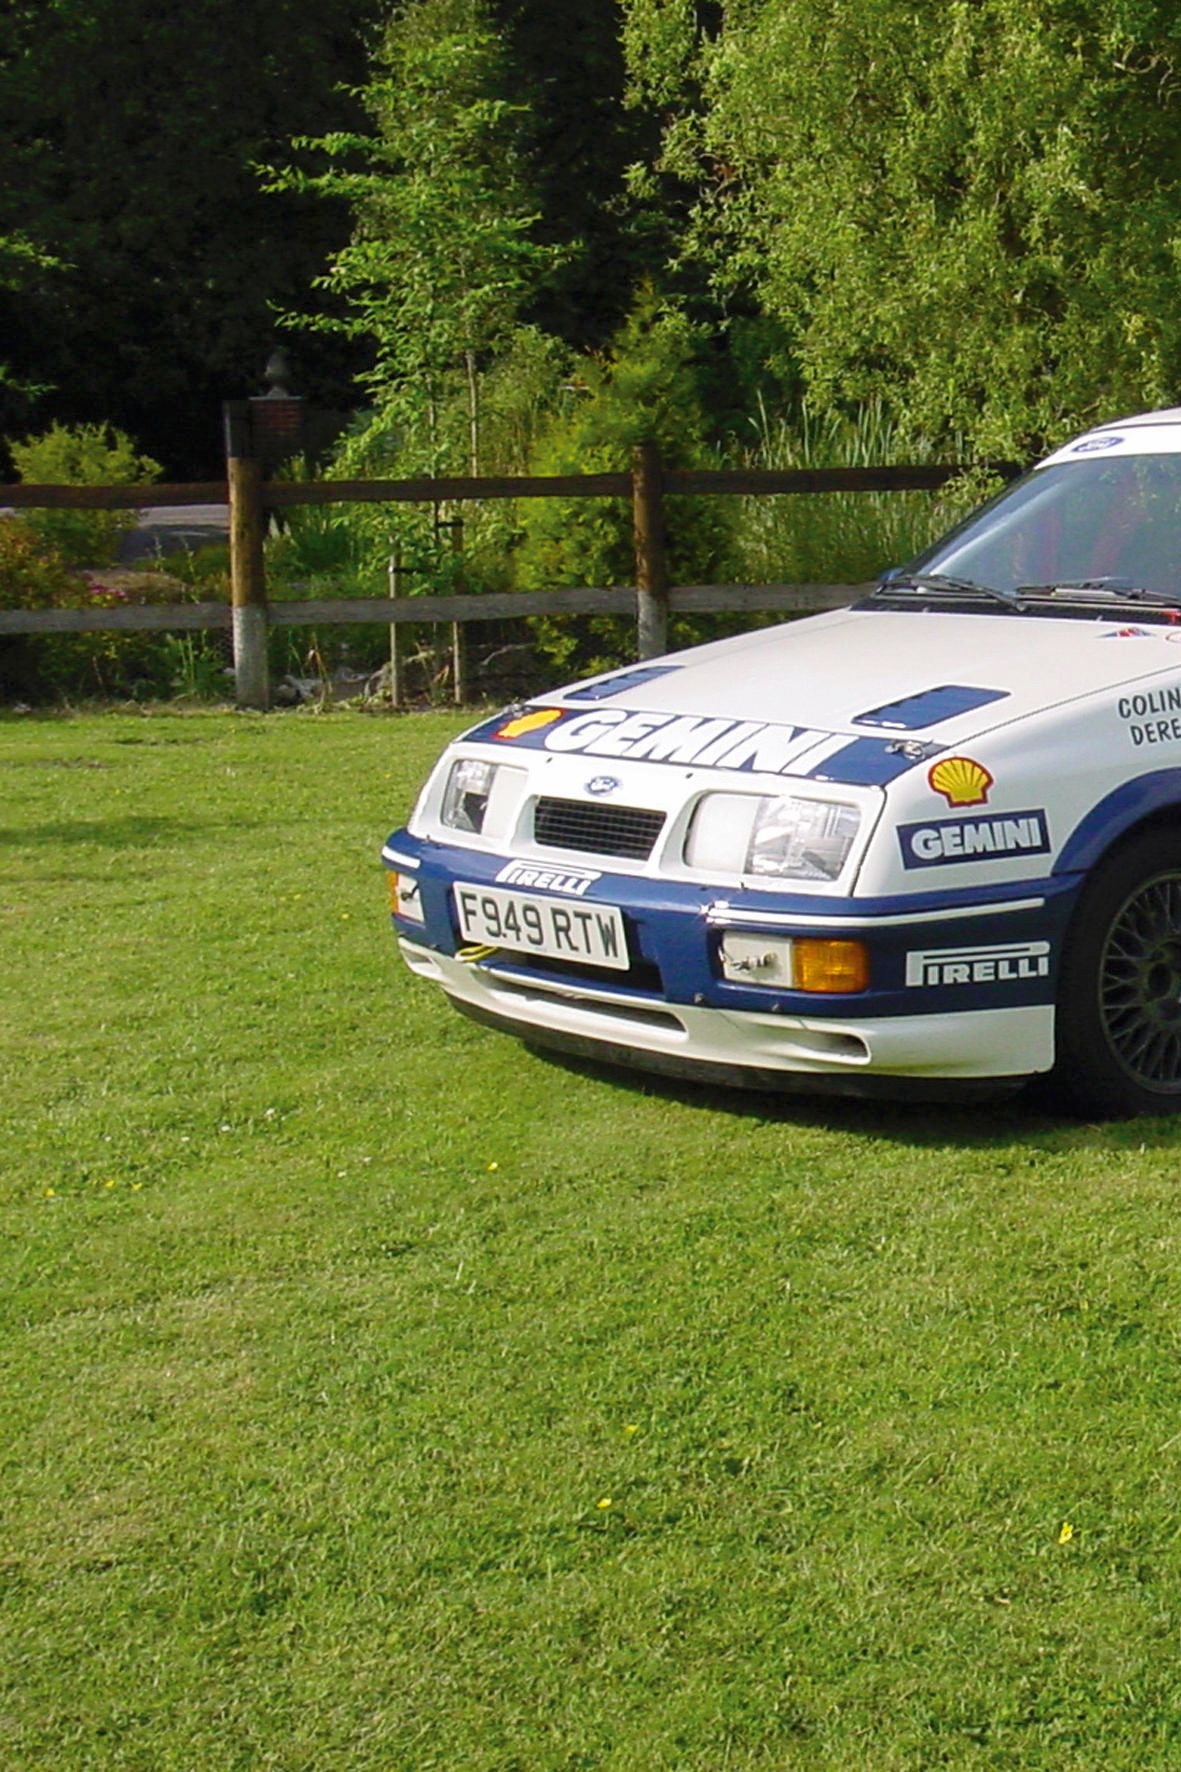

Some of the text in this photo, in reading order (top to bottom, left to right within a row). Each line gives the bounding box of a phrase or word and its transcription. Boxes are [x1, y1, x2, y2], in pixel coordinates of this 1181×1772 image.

[1118, 688, 1181, 718] COLIN
[544, 708, 862, 777] GEMINI
[911, 817, 1043, 860] GEMINI
[495, 858, 603, 896] PIRELLI
[460, 890, 618, 958] F949 RTW
[905, 940, 1051, 987] PIRELLI
